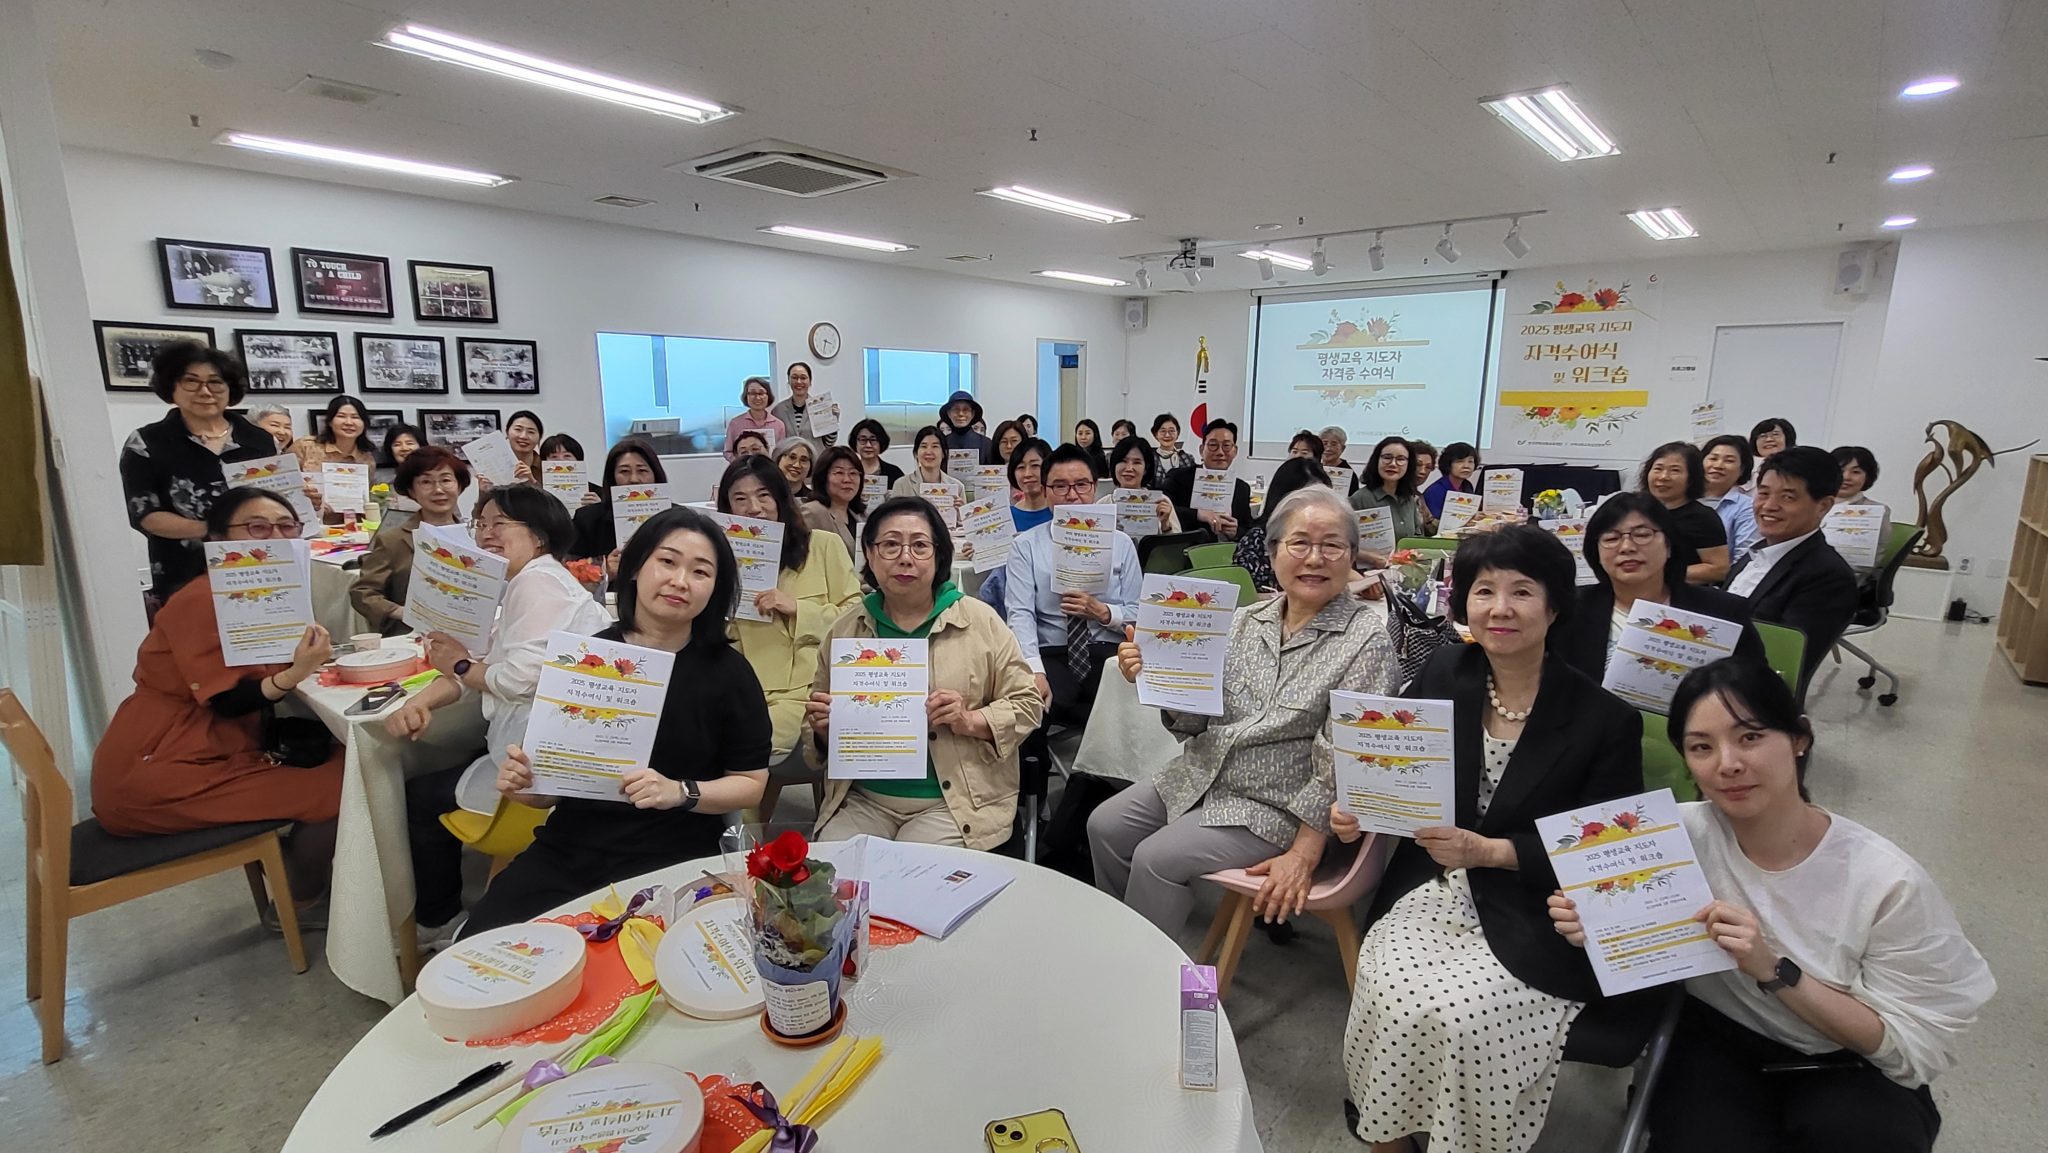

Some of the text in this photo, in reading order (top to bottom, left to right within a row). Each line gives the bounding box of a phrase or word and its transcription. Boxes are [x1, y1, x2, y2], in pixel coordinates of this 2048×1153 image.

[1521, 321, 1633, 335] 2025 평생교육 지도자
[1318, 350, 1402, 366] 평생교육 지도자
[1523, 342, 1618, 361] 자격수여식
[1322, 366, 1395, 381] 자격증 수여식
[1553, 365, 1629, 384] 및 워크숍
[570, 677, 638, 695] 2025 평생교육 지도자
[567, 688, 602, 701] 자격수여식
[616, 696, 637, 706] 워크숍
[1374, 733, 1400, 741] 평생교육
[1586, 839, 1657, 861] 2025 평생교육 지도자
[1588, 851, 1664, 873] 자격수여식 및 워크숍
